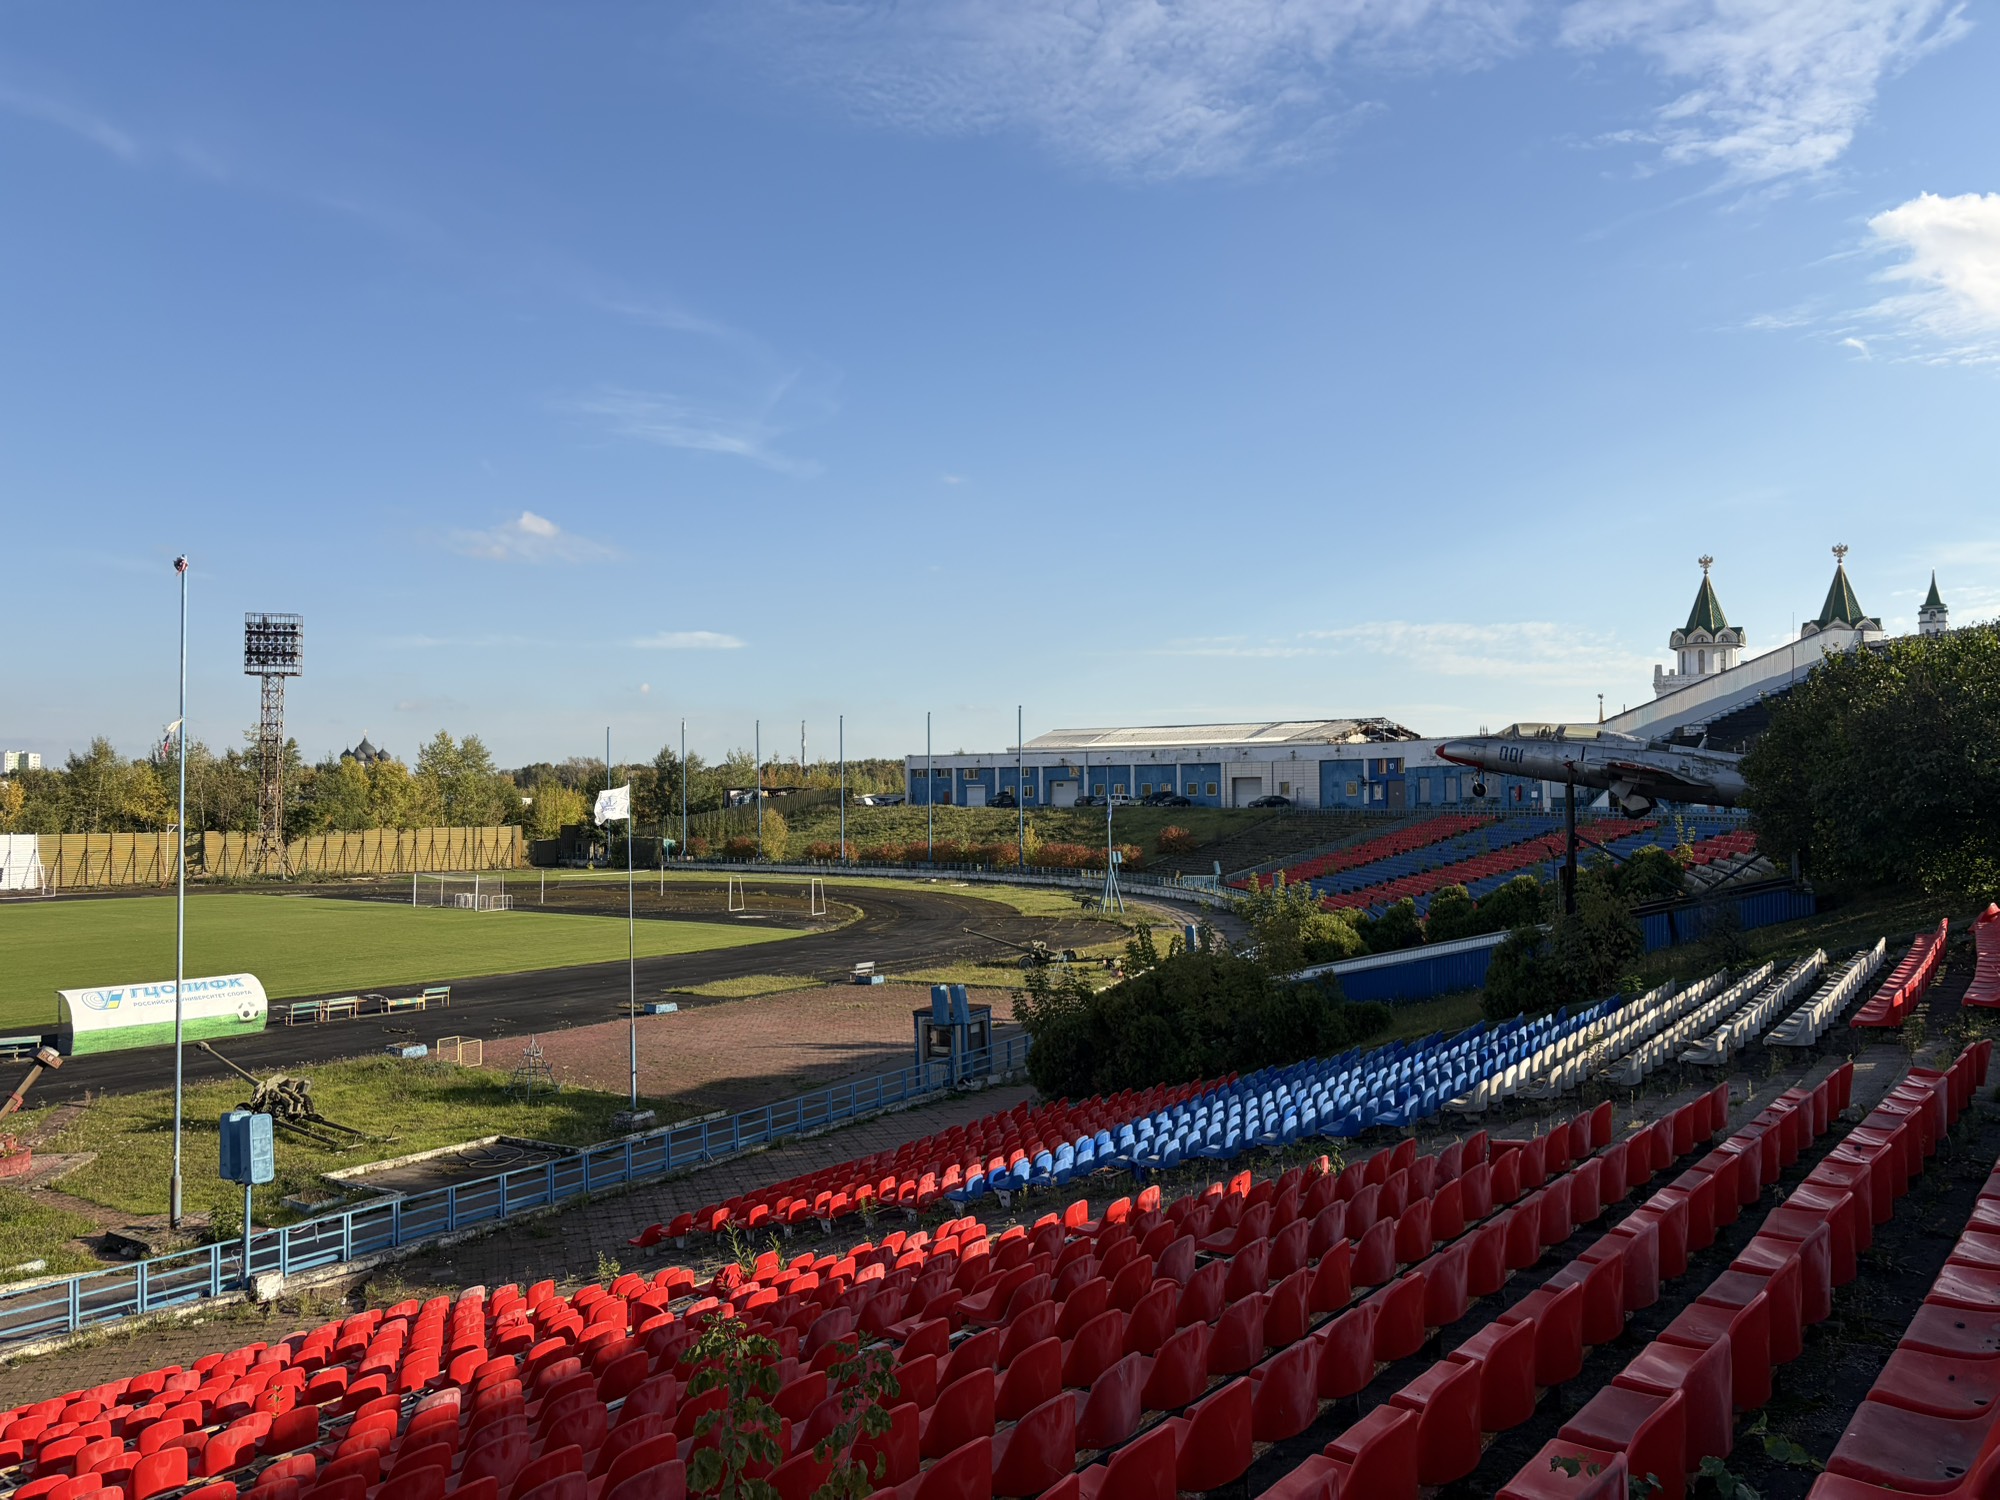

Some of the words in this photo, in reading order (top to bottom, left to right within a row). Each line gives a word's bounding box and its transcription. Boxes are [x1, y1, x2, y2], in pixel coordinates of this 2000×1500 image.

[1499, 746, 1524, 764] 001
[129, 977, 245, 999] ГЦОЛИФК
[133, 998, 178, 1007] РОССИЙСКИ
[227, 990, 252, 998] СПОРТА
